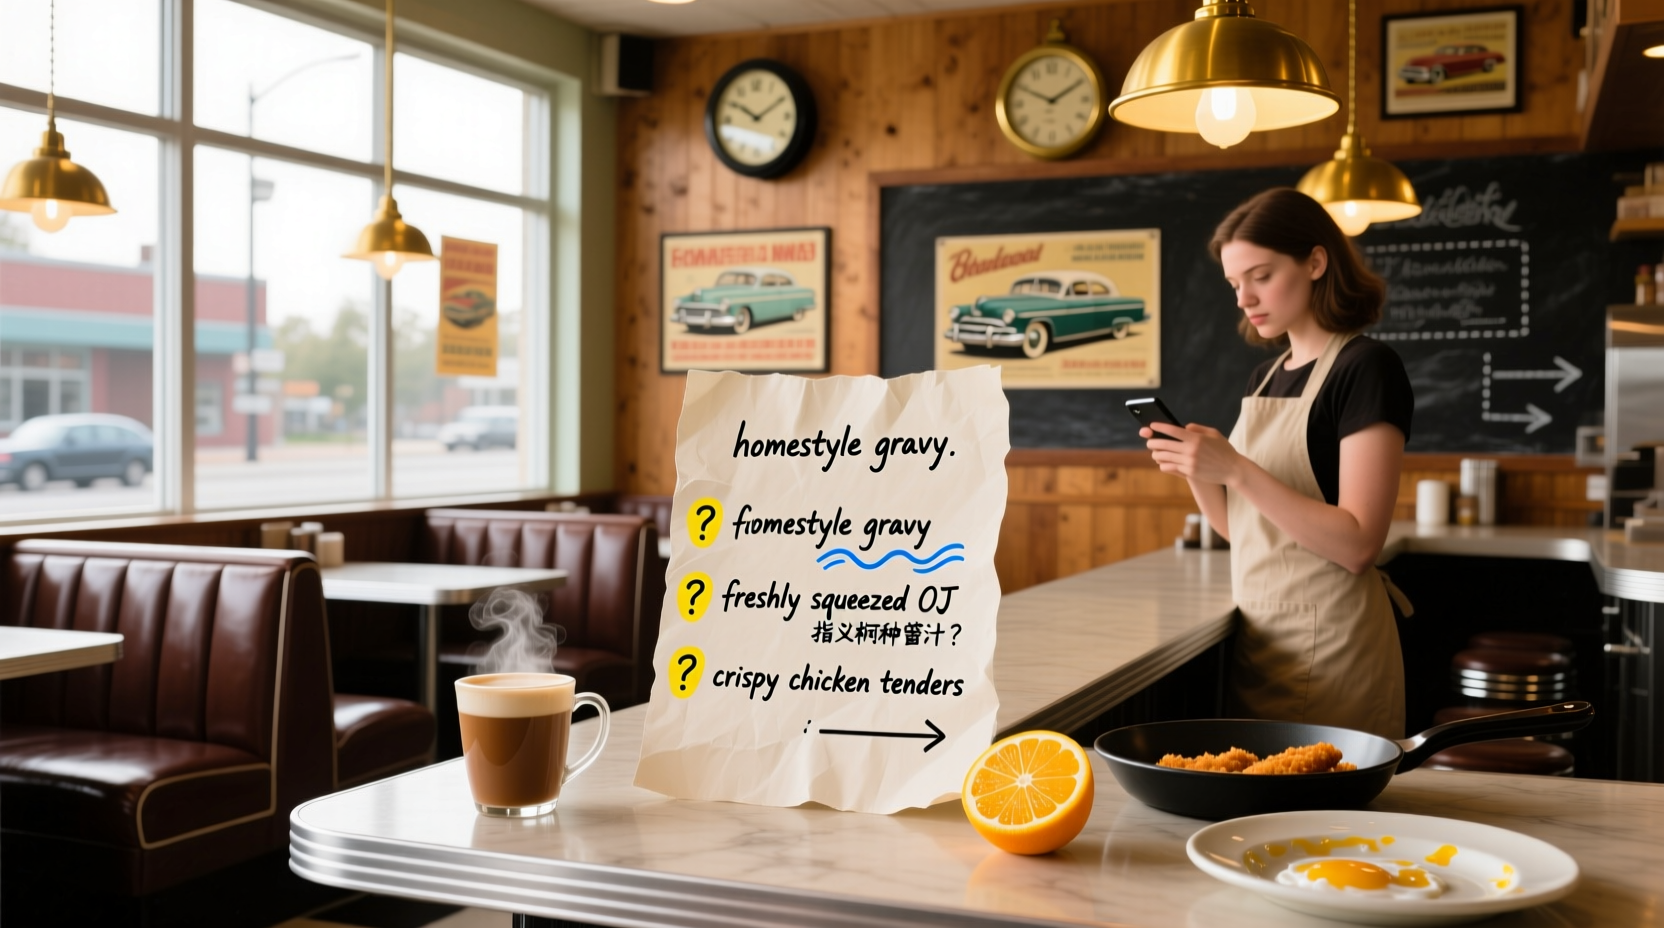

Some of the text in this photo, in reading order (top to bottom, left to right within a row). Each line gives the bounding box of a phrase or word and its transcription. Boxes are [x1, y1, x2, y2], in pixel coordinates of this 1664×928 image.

[732, 420, 956, 473] homestyle gravy.
[695, 504, 717, 541] ?
[858, 518, 931, 551] gravy
[686, 579, 960, 622] ? freshly squeezed OJ
[677, 653, 965, 701] ? crispy chicken tenders
